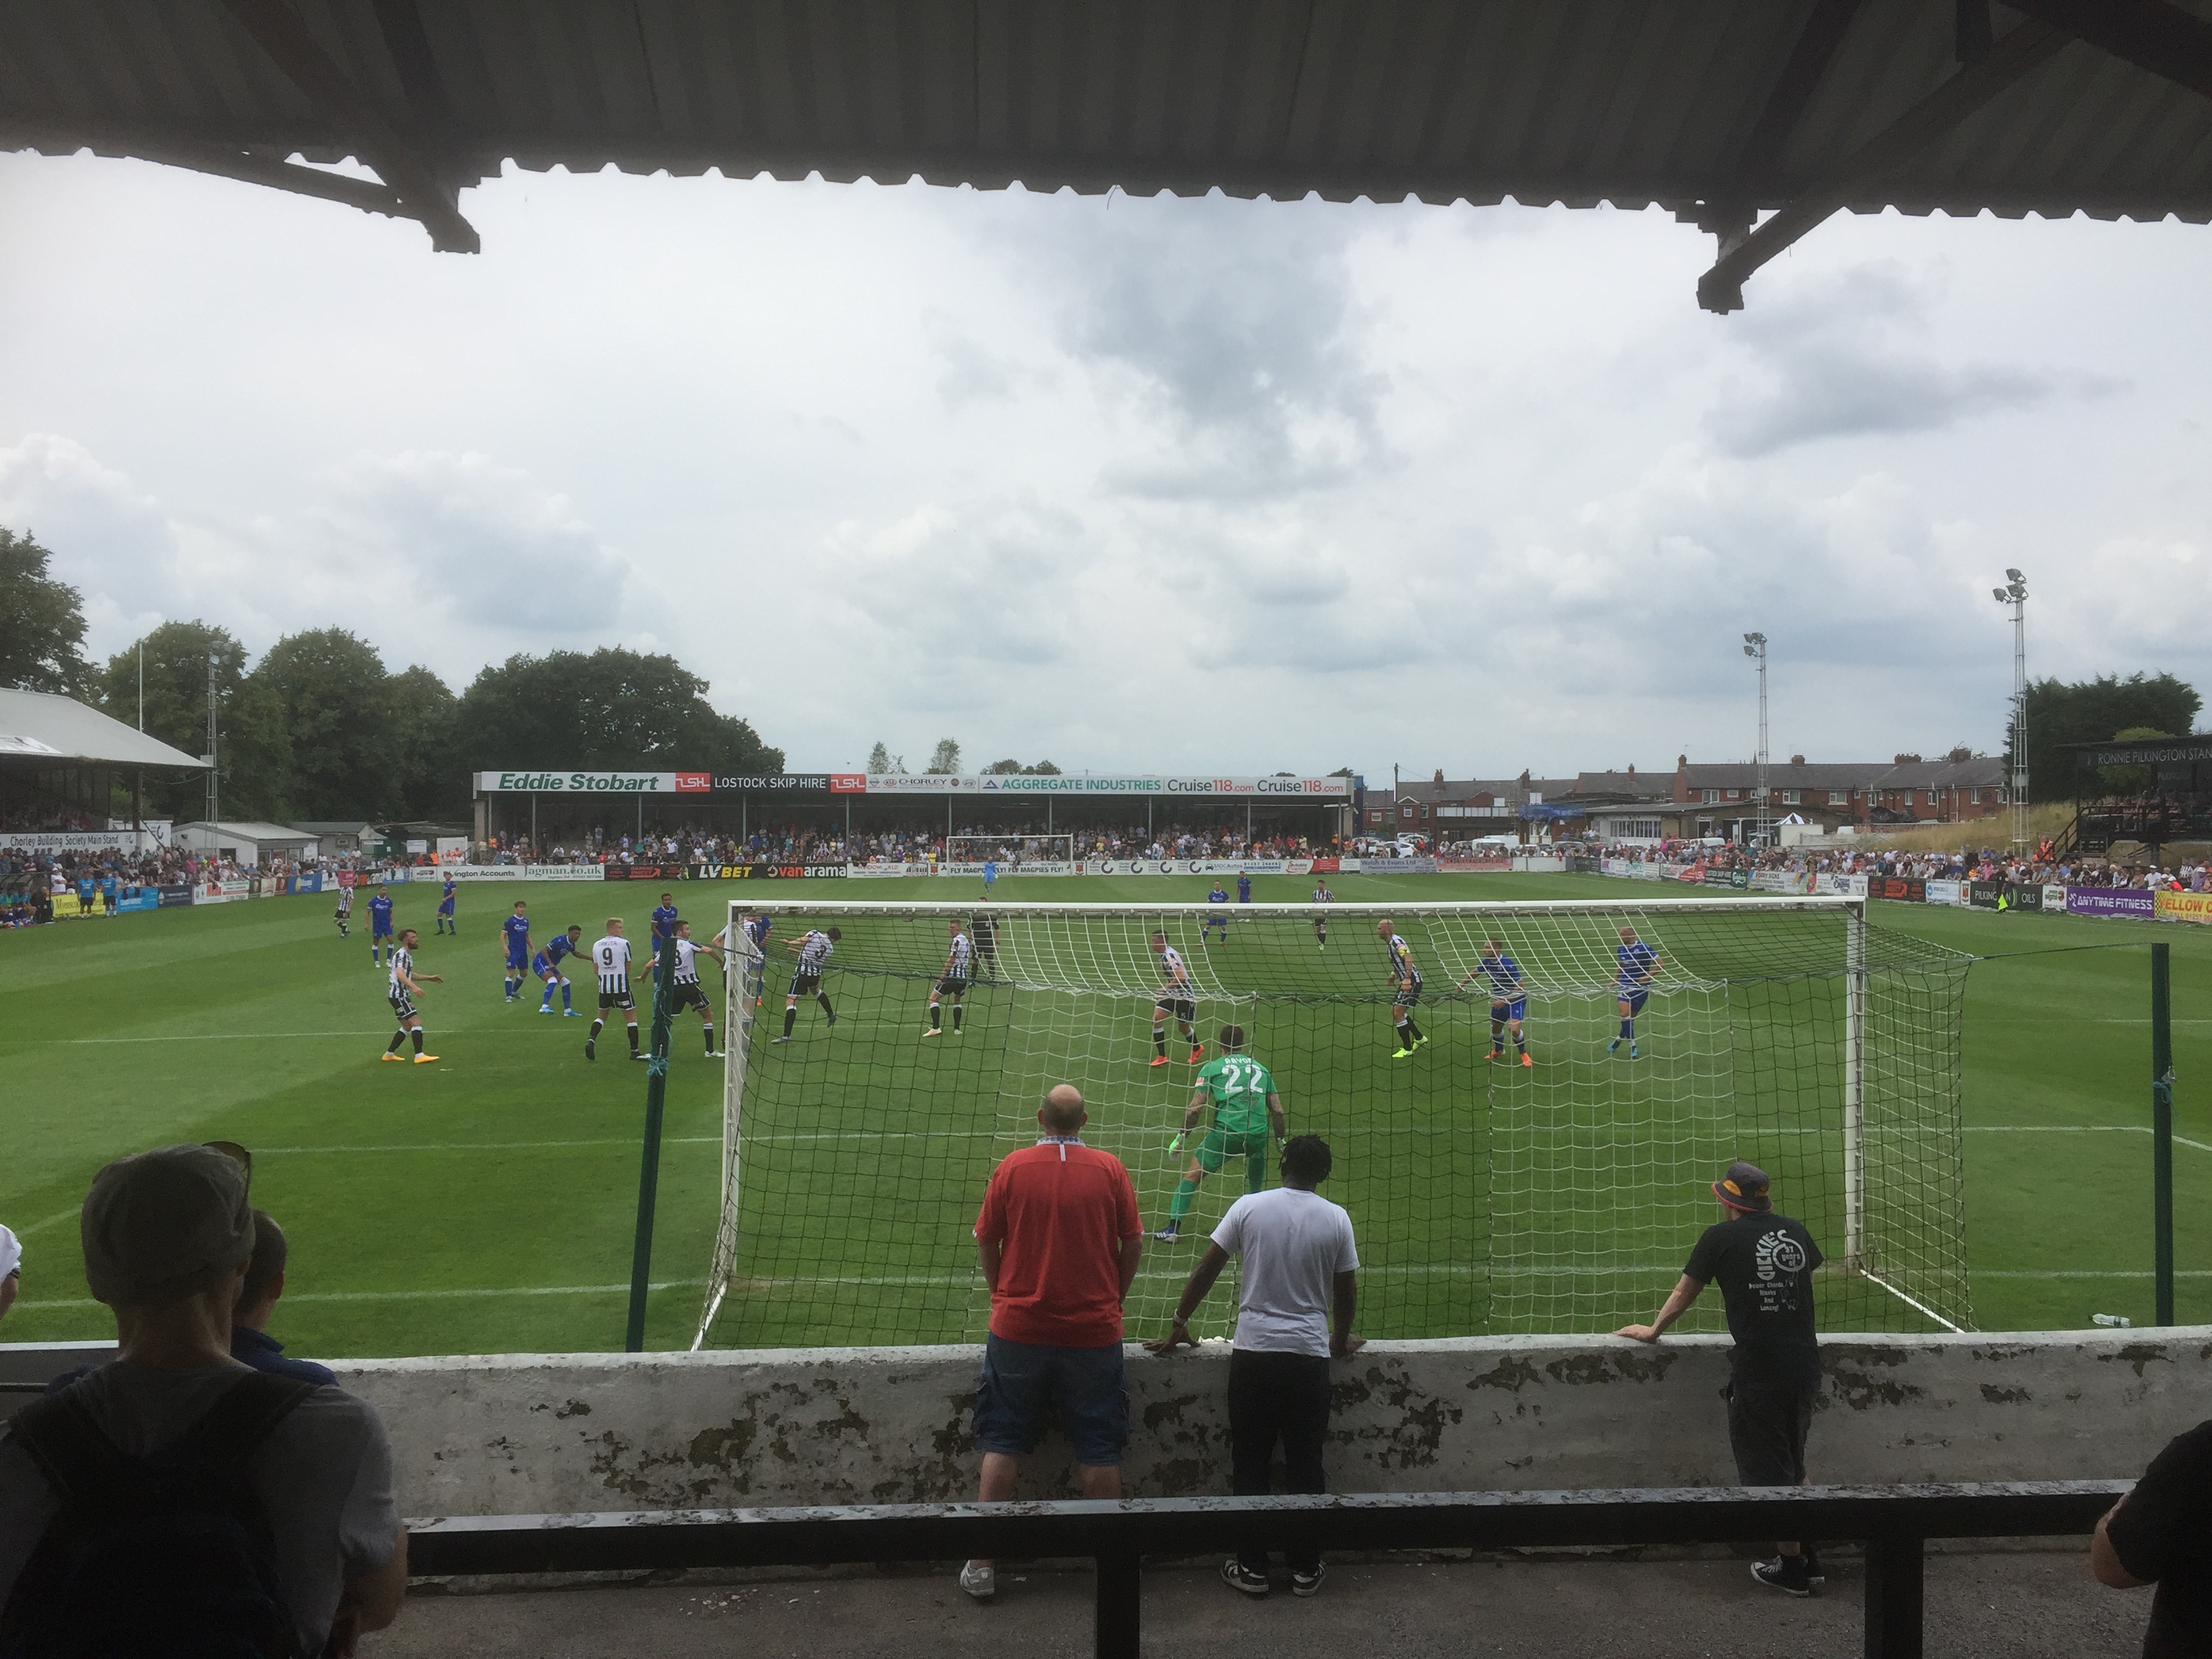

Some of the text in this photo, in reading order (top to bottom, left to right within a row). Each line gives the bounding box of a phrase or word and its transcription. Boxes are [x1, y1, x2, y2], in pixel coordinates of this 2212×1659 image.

[2098, 752, 2130, 764] RONNIE
[2133, 748, 2186, 762] PILKINGTON
[498, 773, 659, 790] Eddie Stobart
[714, 777, 826, 789] LOSTOCK SKIP HIRE
[1002, 779, 1161, 790] AGGREGATE INDUSTRIES
[1168, 779, 1254, 792] Cruise118.com
[1257, 779, 1343, 792] Cruise118.com
[10, 836, 35, 848] Chorley
[37, 836, 63, 848] Building
[65, 835, 87, 847] Society
[87, 834, 102, 844] Main
[102, 834, 119, 844] Stand
[525, 865, 602, 878] Jagman.co.uk
[779, 865, 846, 878] vanarama
[1975, 890, 2036, 903] PILKINGN OILS
[2077, 895, 2153, 910] ANYTIME FITNESS
[2159, 898, 2203, 912] YELLOW
[602, 947, 613, 966] 9
[1221, 1064, 1263, 1093] 22
[1782, 1254, 1801, 1262] years
